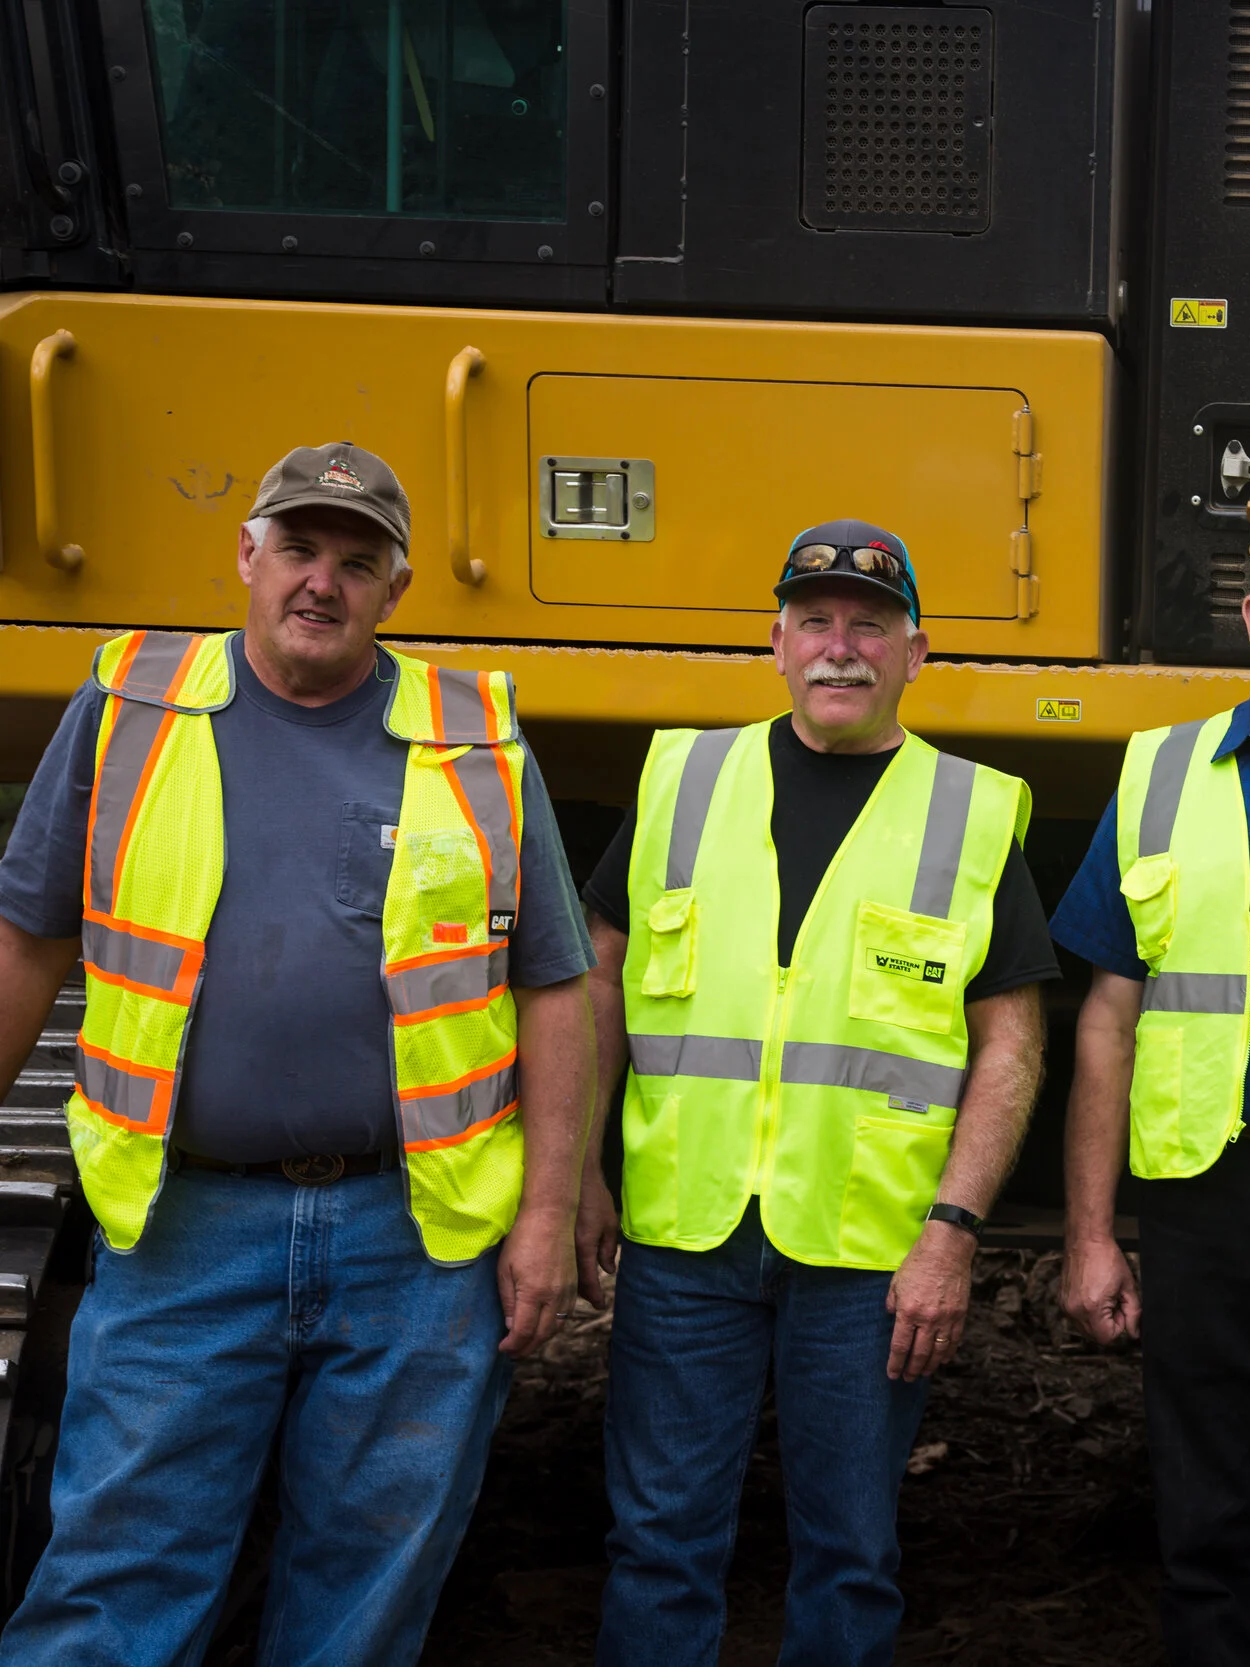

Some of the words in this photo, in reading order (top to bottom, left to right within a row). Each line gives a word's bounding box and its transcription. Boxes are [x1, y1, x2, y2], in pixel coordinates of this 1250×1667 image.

[491, 915, 513, 930] CAT
[888, 963, 911, 973] STATES
[890, 957, 920, 969] WESTERN
[925, 965, 944, 979] CAT
